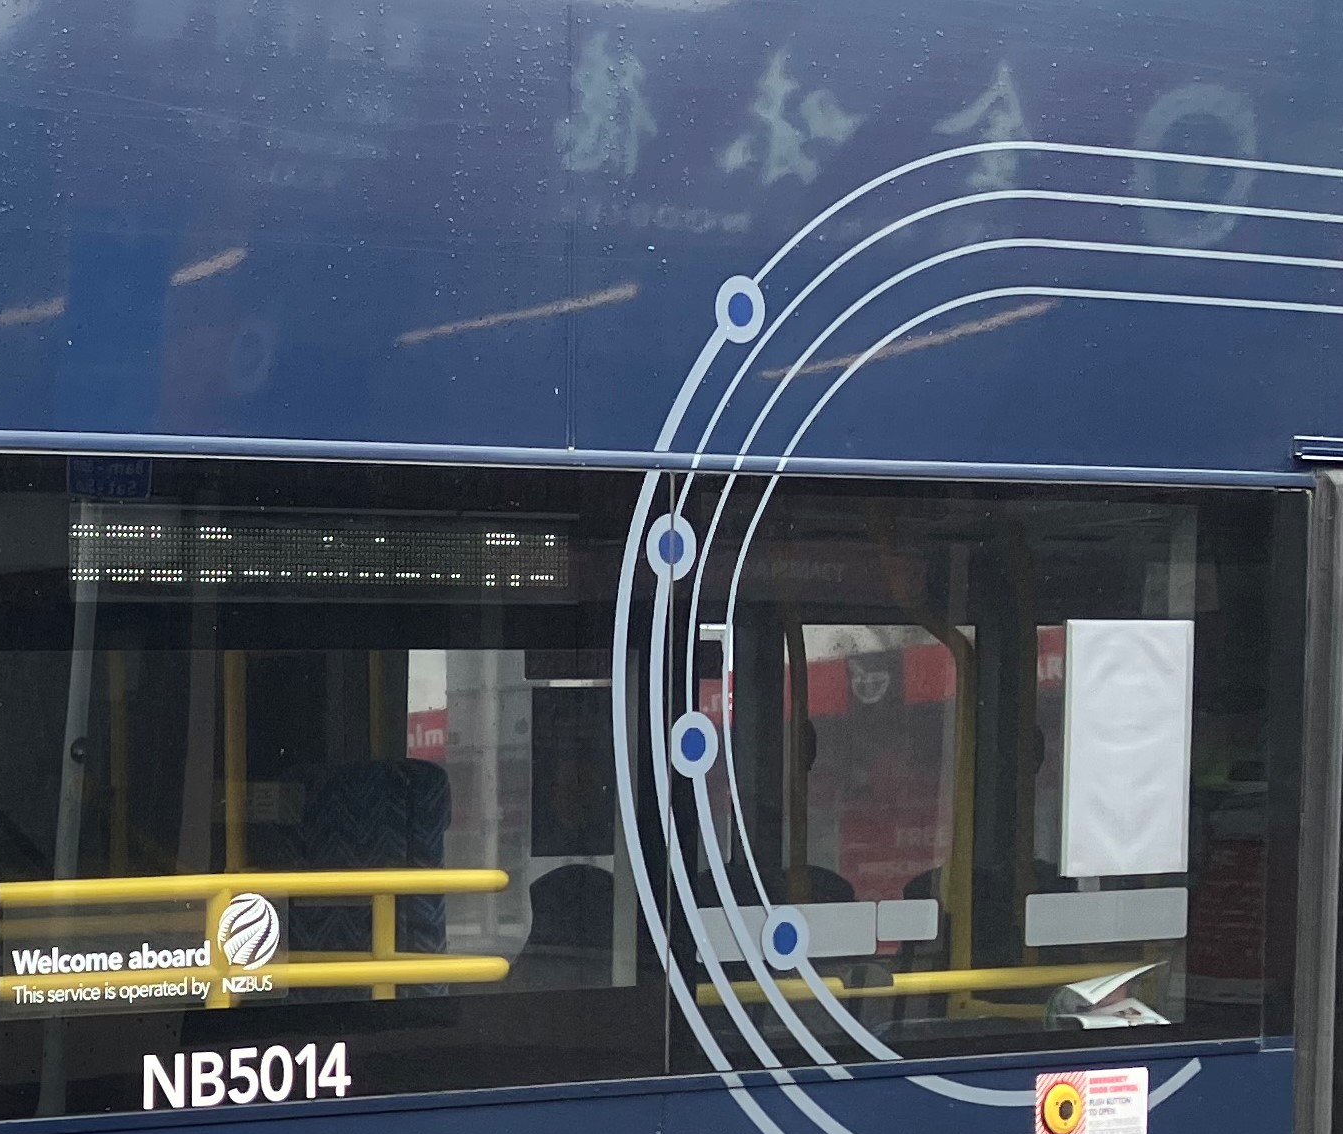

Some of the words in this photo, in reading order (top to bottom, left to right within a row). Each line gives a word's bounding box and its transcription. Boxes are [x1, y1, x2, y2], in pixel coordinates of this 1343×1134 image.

[11, 946, 124, 975] Welcome
[129, 940, 211, 970] aboard
[11, 985, 45, 1004] This
[47, 983, 101, 1002] service
[105, 982, 117, 1000] is
[119, 976, 188, 1003] operated
[191, 975, 211, 1000] by
[221, 974, 273, 994] NZBUS
[142, 1042, 351, 1110] NB5014
